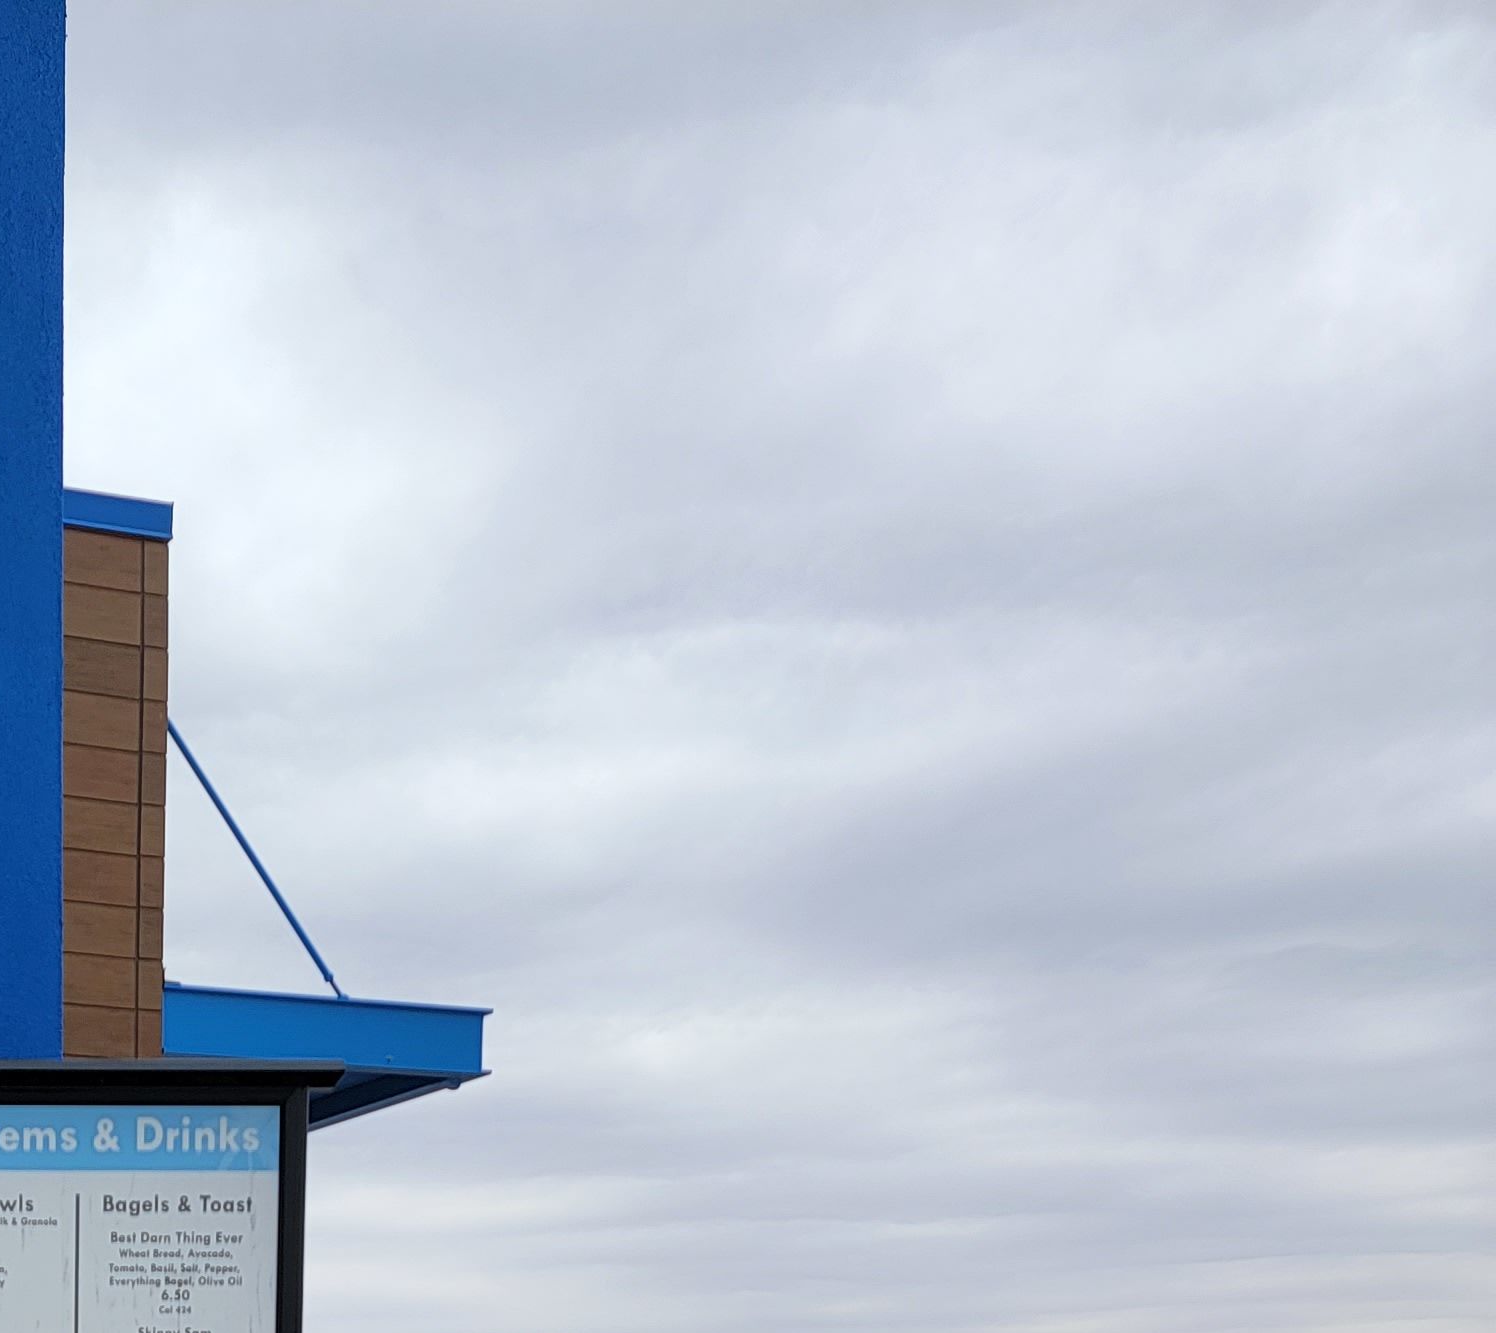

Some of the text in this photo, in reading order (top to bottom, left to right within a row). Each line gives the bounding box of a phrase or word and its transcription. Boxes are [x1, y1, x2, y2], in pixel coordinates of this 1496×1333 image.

[94, 1118, 120, 1152] &
[136, 1117, 260, 1152] Drinks
[103, 1194, 252, 1216] Bagels & Toast
[110, 1231, 243, 1246] Best Darn Thing Ever
[109, 1276, 161, 1289] Everything
[161, 1288, 190, 1301] 6.50
